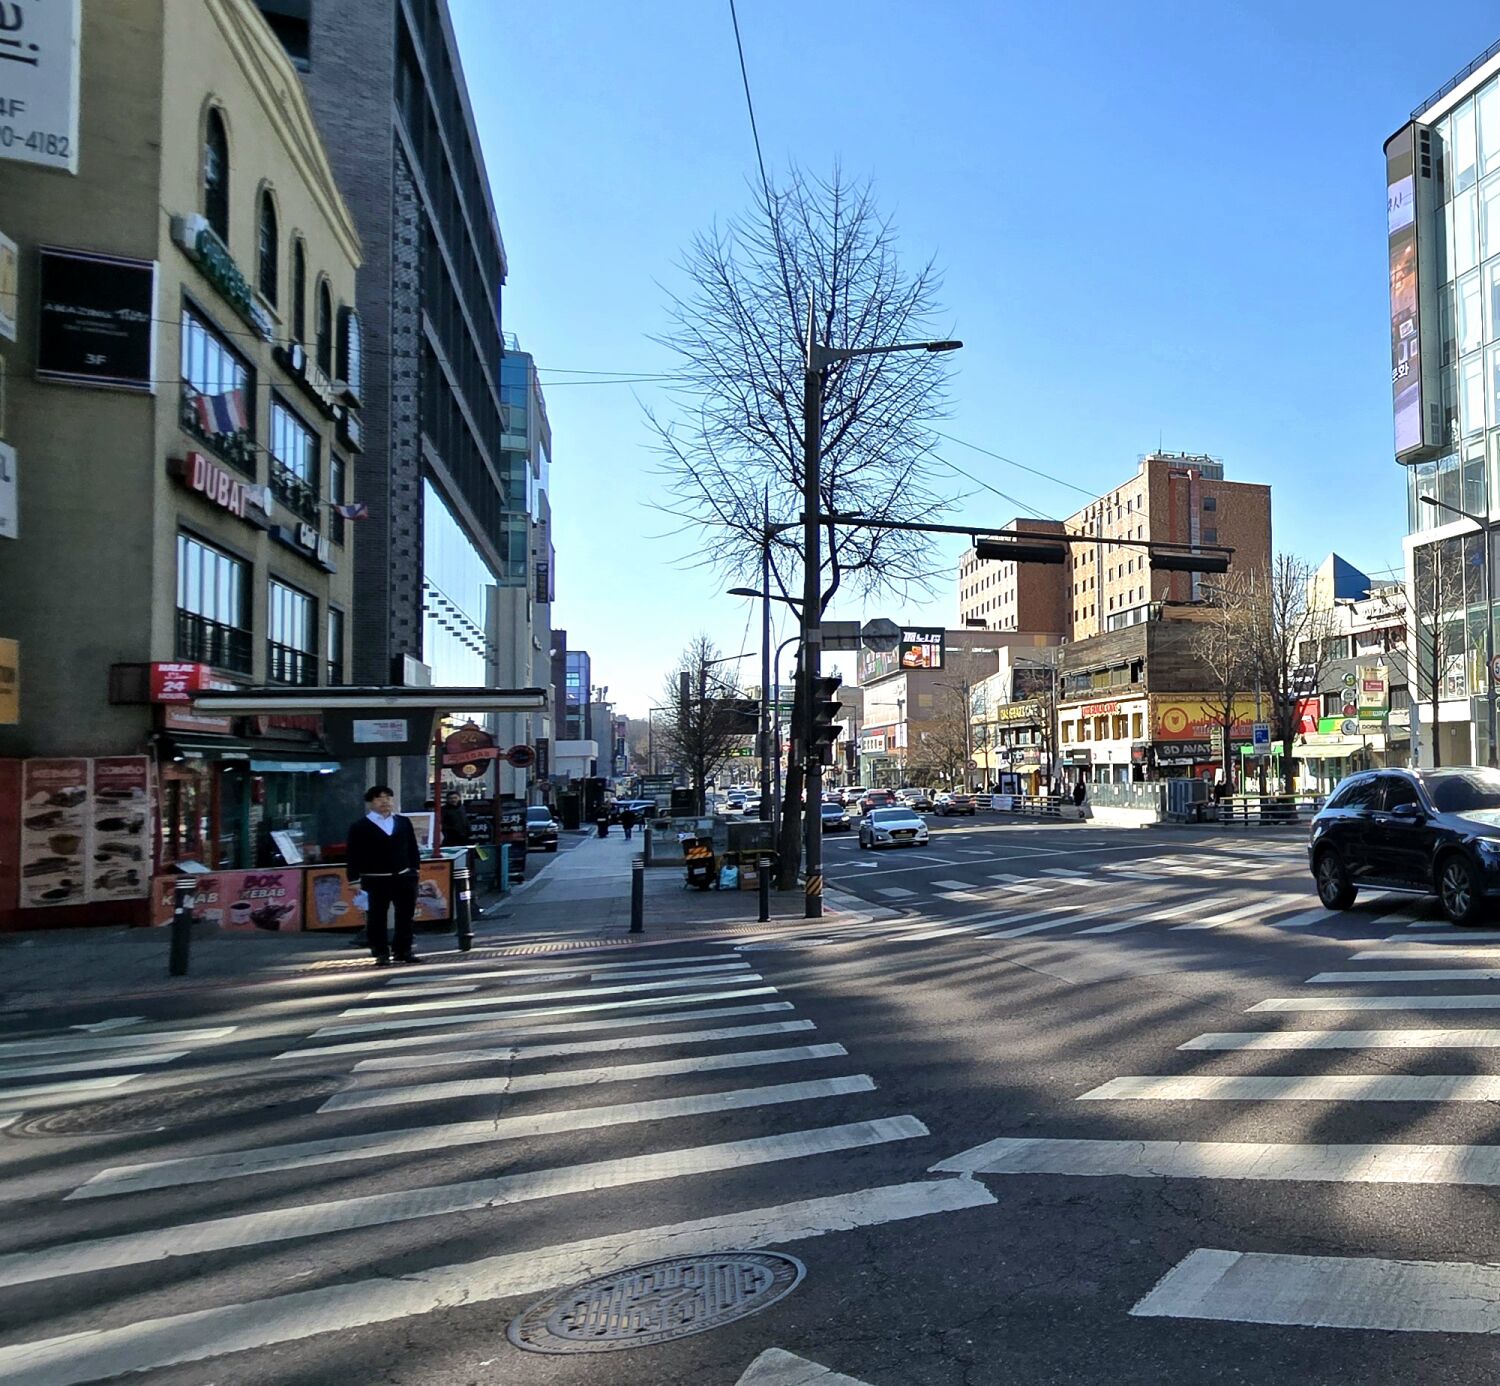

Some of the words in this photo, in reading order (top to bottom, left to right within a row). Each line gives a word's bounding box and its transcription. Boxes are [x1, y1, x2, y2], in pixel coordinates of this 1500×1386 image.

[0, 126, 69, 158] 0-4182
[85, 353, 107, 365] 3F
[193, 452, 248, 519] DUBAI
[163, 681, 186, 692] 24
[244, 874, 284, 888] BOX
[240, 888, 285, 899] KEBAB
